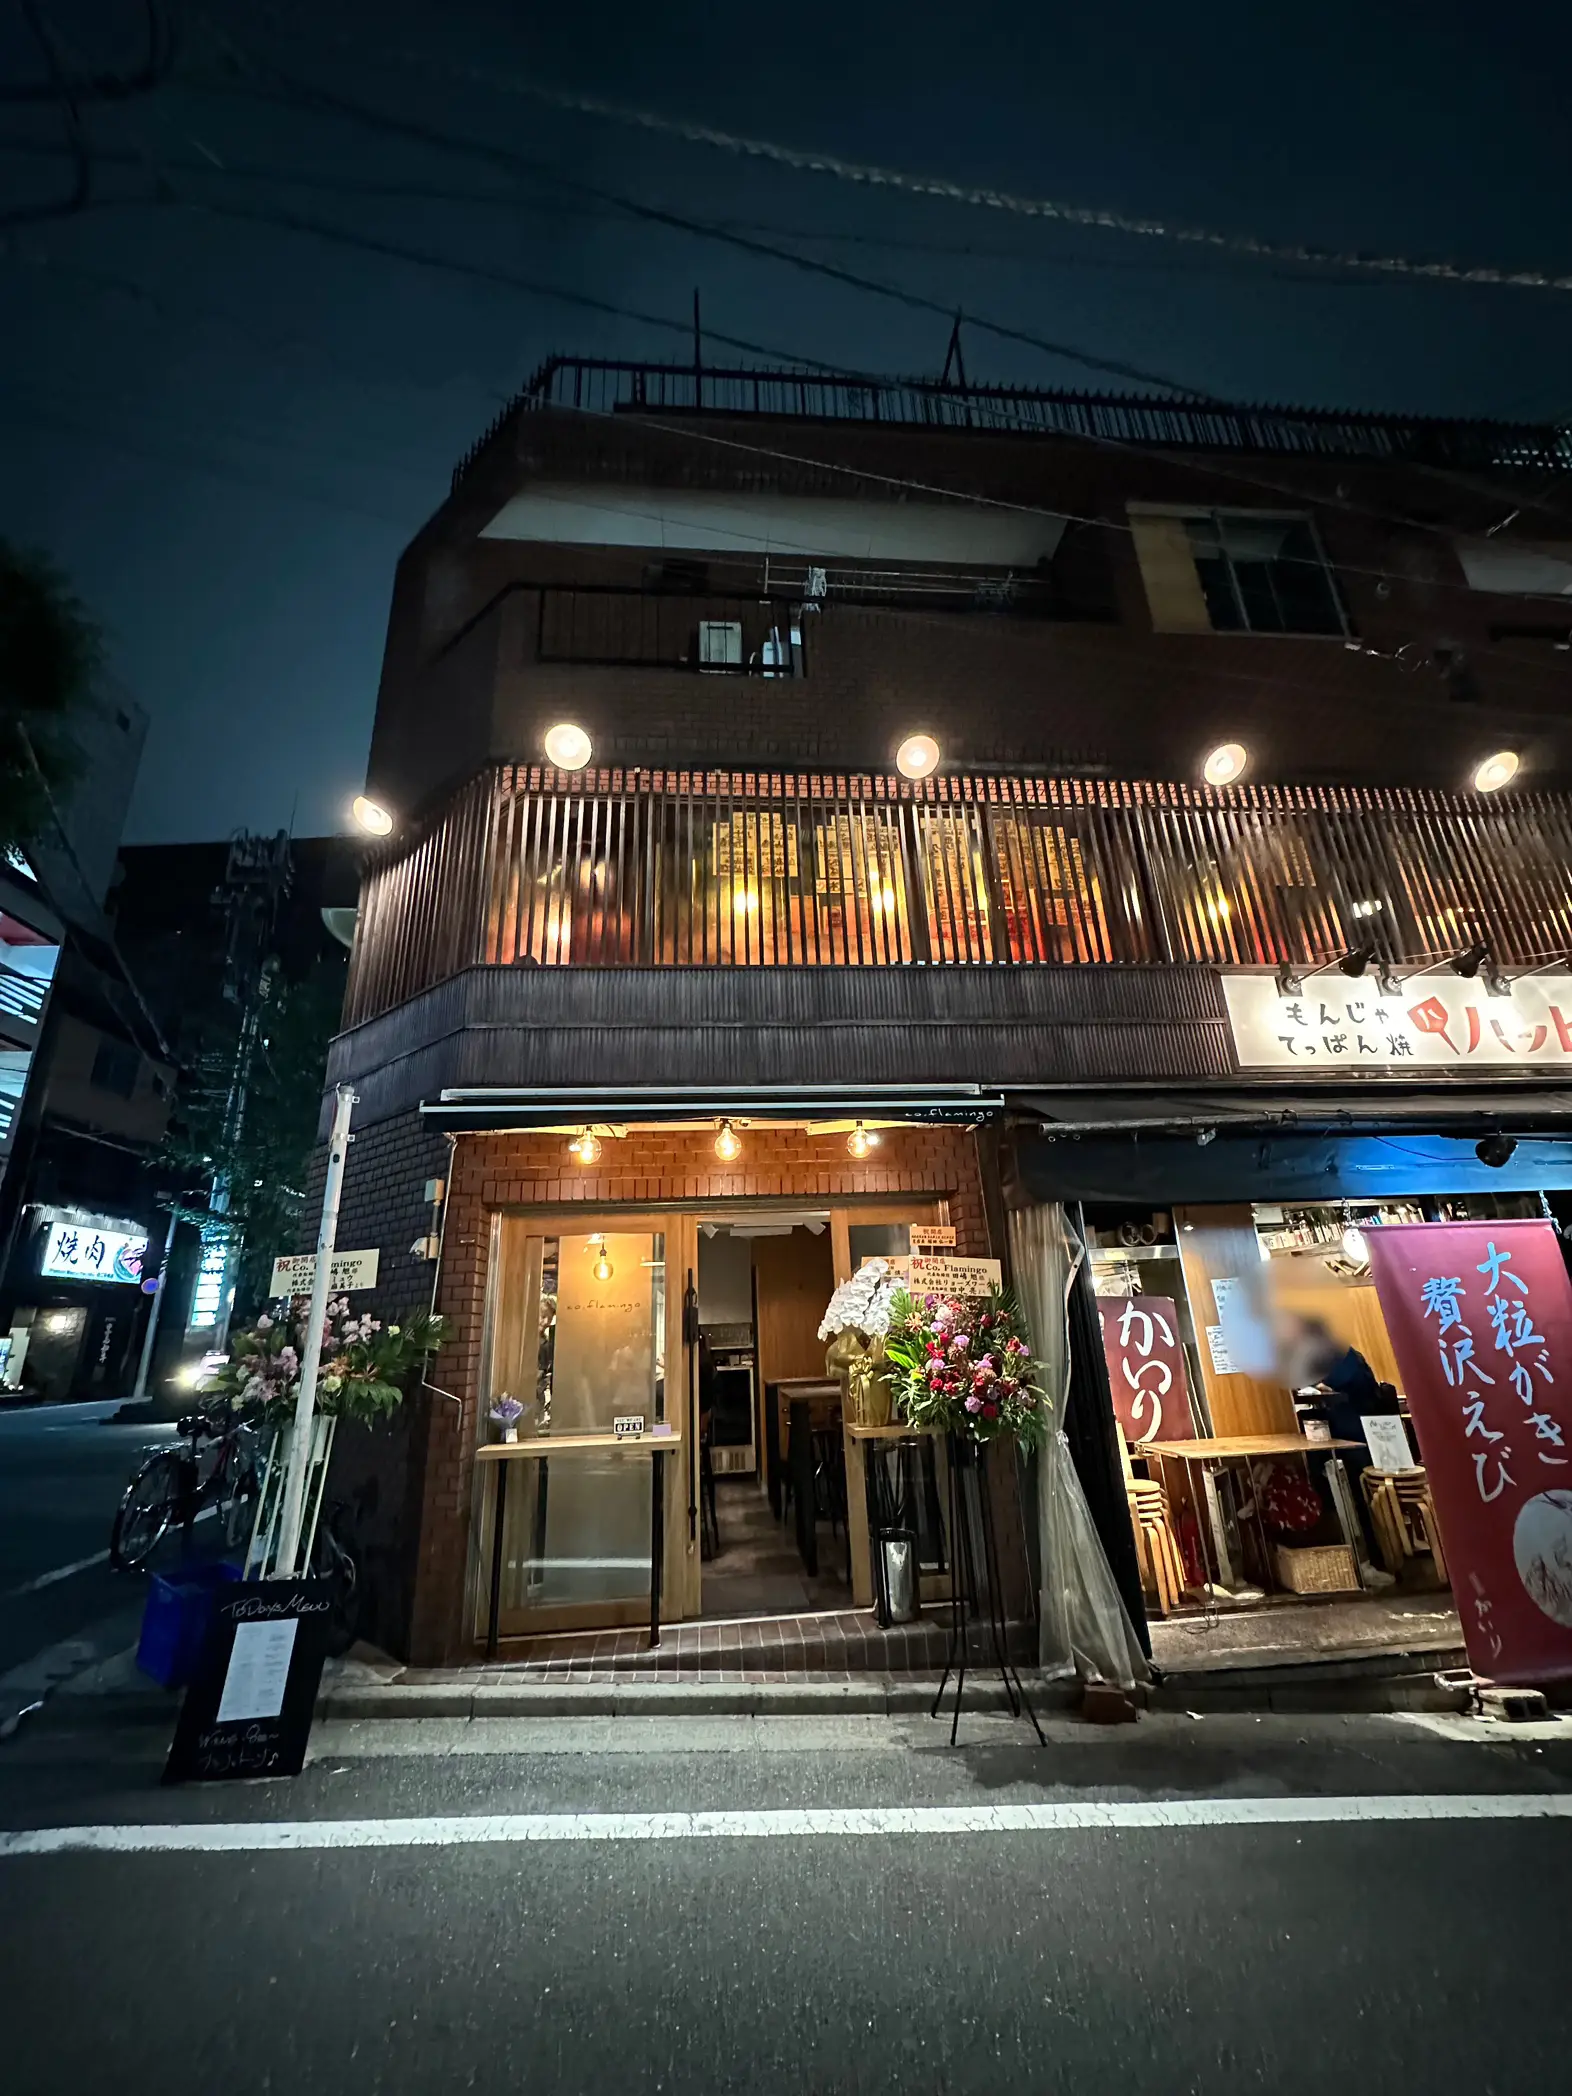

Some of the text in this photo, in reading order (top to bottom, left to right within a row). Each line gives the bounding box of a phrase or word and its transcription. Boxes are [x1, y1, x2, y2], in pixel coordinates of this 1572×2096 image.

[1286, 1003, 1389, 1026] もんじゃ
[1278, 1034, 1415, 1057] てっぱん焼
[52, 1231, 106, 1269] 焼肉
[276, 1259, 291, 1272] 祝
[911, 1257, 924, 1270] 祝
[944, 1265, 987, 1274] Flamingo
[1477, 1241, 1569, 1465] 大粒がき
[1116, 1301, 1175, 1443] かいり
[1420, 1276, 1517, 1503] 贅沢えび
[616, 1422, 641, 1432] OPEN
